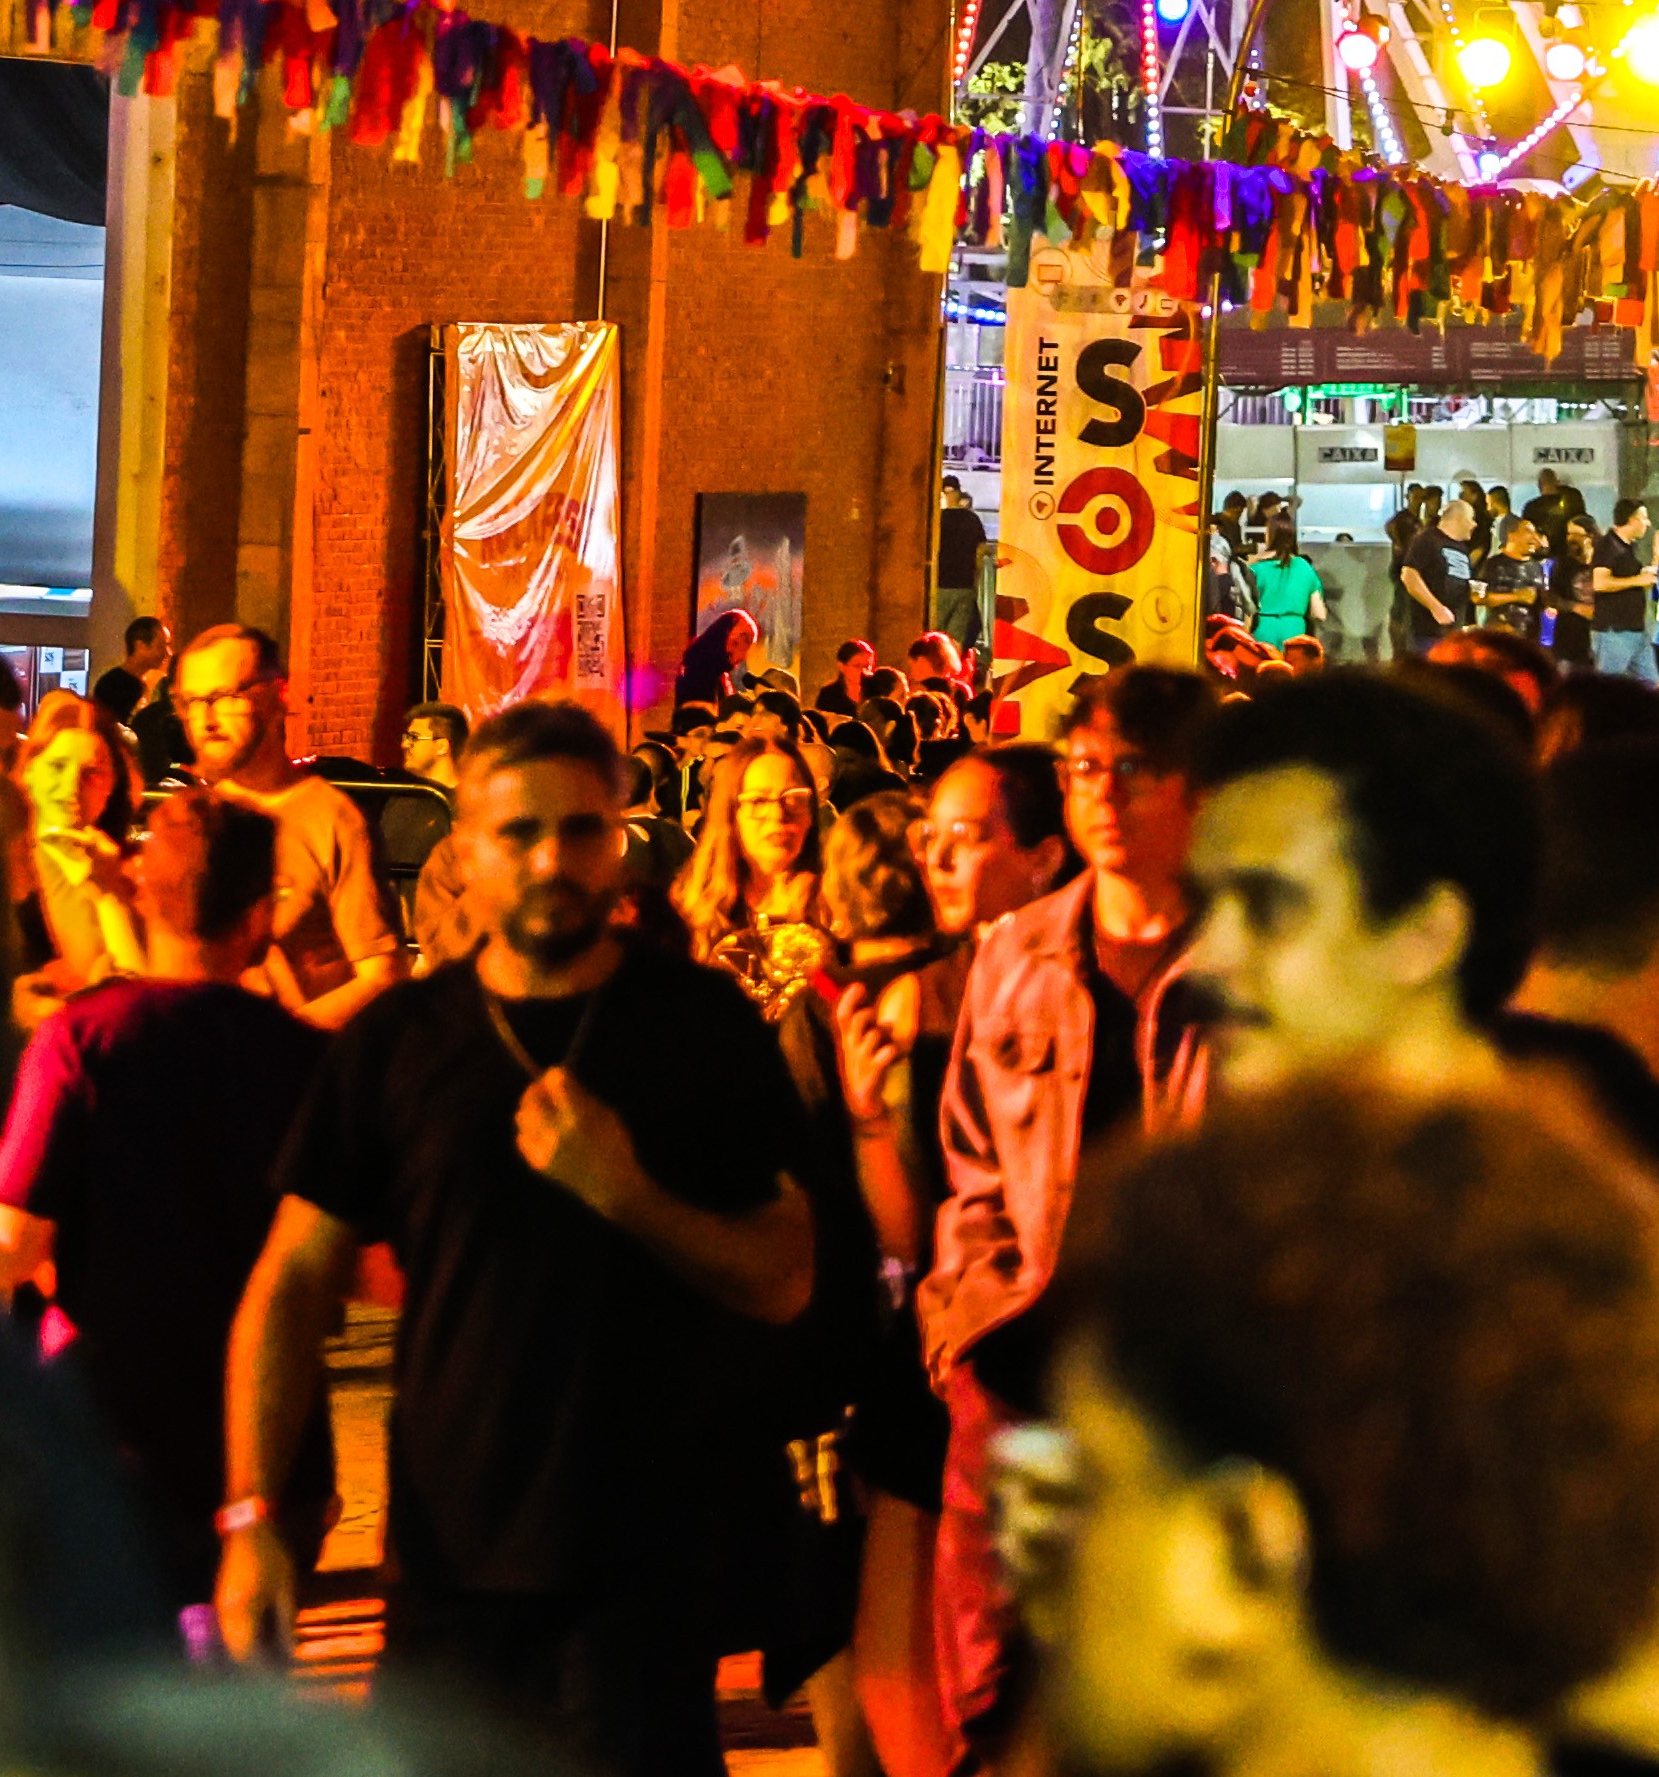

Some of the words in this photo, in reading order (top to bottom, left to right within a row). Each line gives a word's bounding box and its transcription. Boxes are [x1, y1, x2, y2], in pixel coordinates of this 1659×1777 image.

[1034, 336, 1060, 486] INTERNET
[1318, 447, 1378, 463] CAIXA
[1533, 447, 1595, 464] CAIXA
